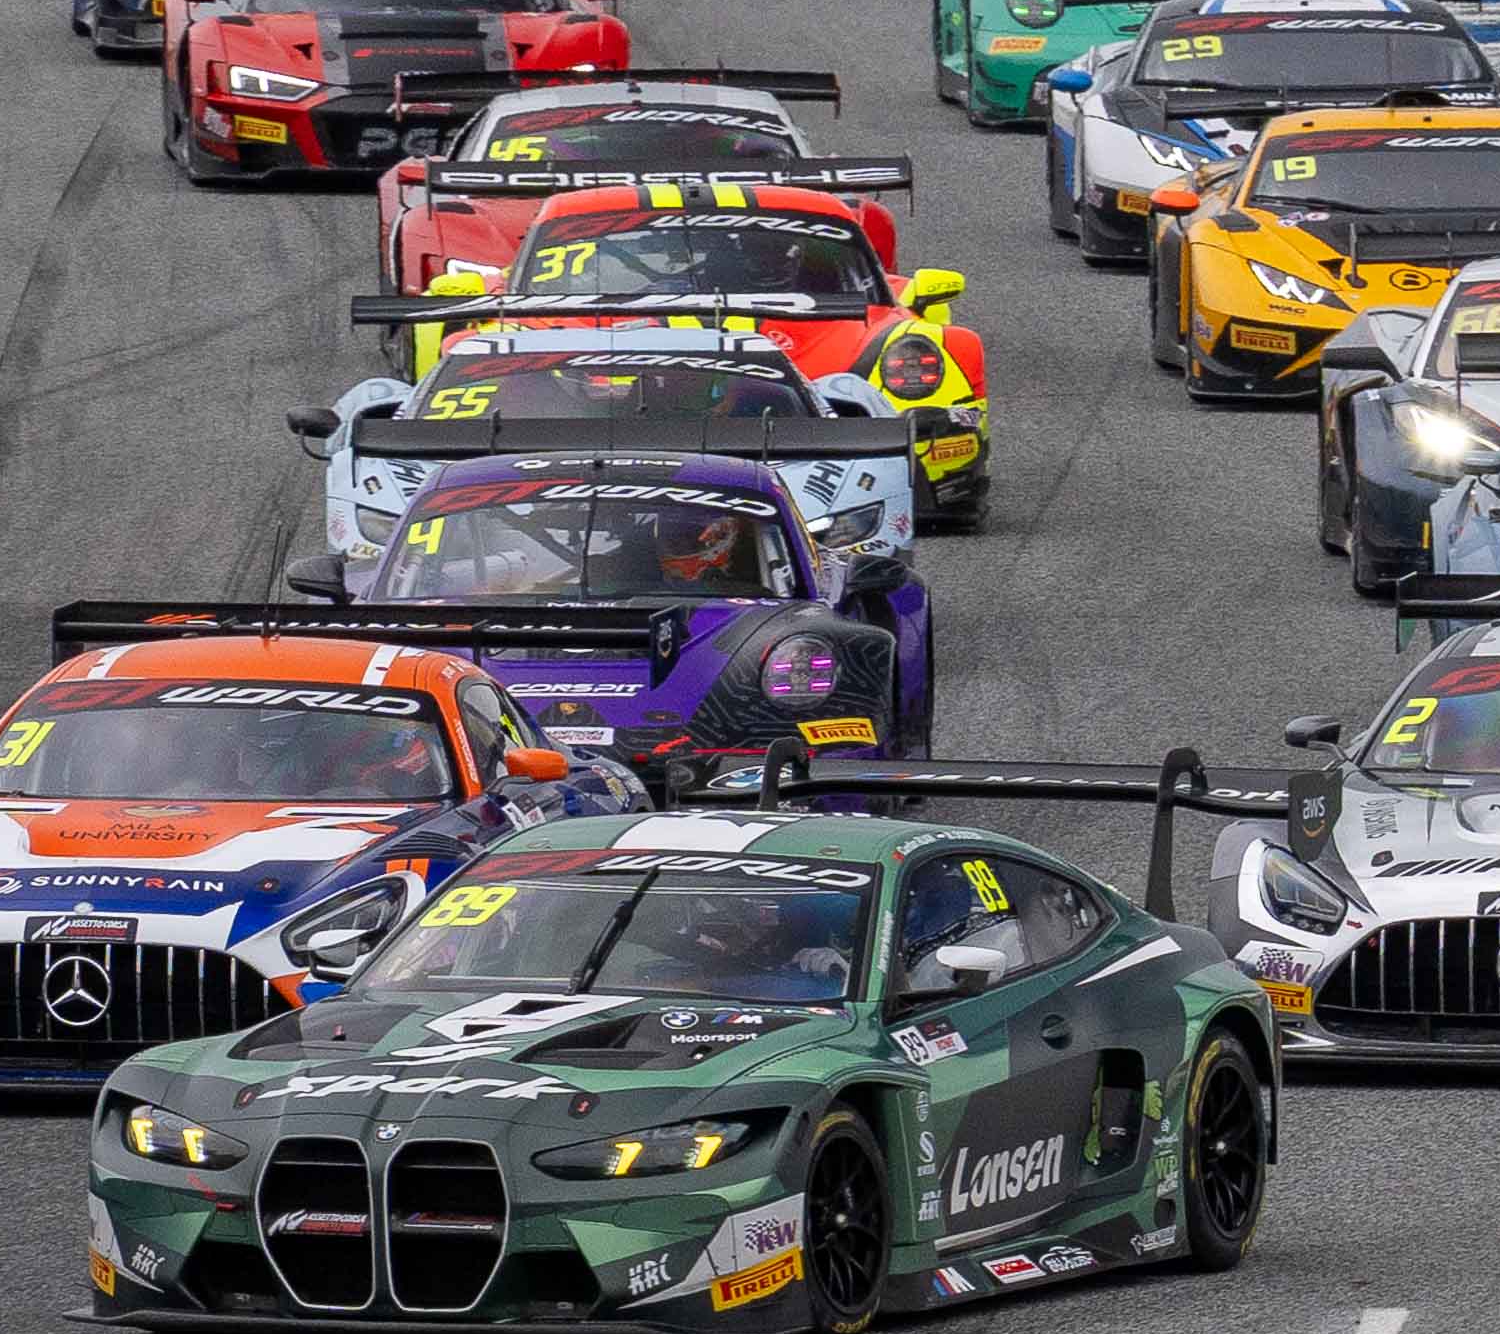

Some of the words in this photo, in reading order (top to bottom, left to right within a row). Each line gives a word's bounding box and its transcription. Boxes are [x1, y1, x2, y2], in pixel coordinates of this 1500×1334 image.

[1268, 17, 1446, 33] WORLD
[1161, 35, 1224, 63] 29
[602, 107, 794, 135] WORLD
[488, 136, 549, 163] 45
[1271, 155, 1318, 183] 19
[647, 214, 853, 241] WORLD
[531, 242, 597, 285] 37
[1235, 328, 1292, 353] PIRELLI
[566, 353, 787, 380] WORLD
[424, 385, 499, 421] 55
[540, 483, 779, 517] WORLD
[406, 517, 445, 555] 4
[157, 685, 421, 716] WORLD
[809, 721, 874, 743] PIRELLI
[1382, 697, 1439, 744] 2
[58, 829, 219, 843] UNIVERSITY
[30, 874, 226, 893] SUNNYRAIN
[596, 853, 872, 890] WORLD
[961, 858, 1010, 914] 89
[419, 886, 519, 928] 89
[670, 1031, 759, 1047] Motorsport
[260, 1074, 584, 1101] spark
[950, 1133, 1065, 1217] Lonsen
[720, 1255, 799, 1302] PIRELLI
